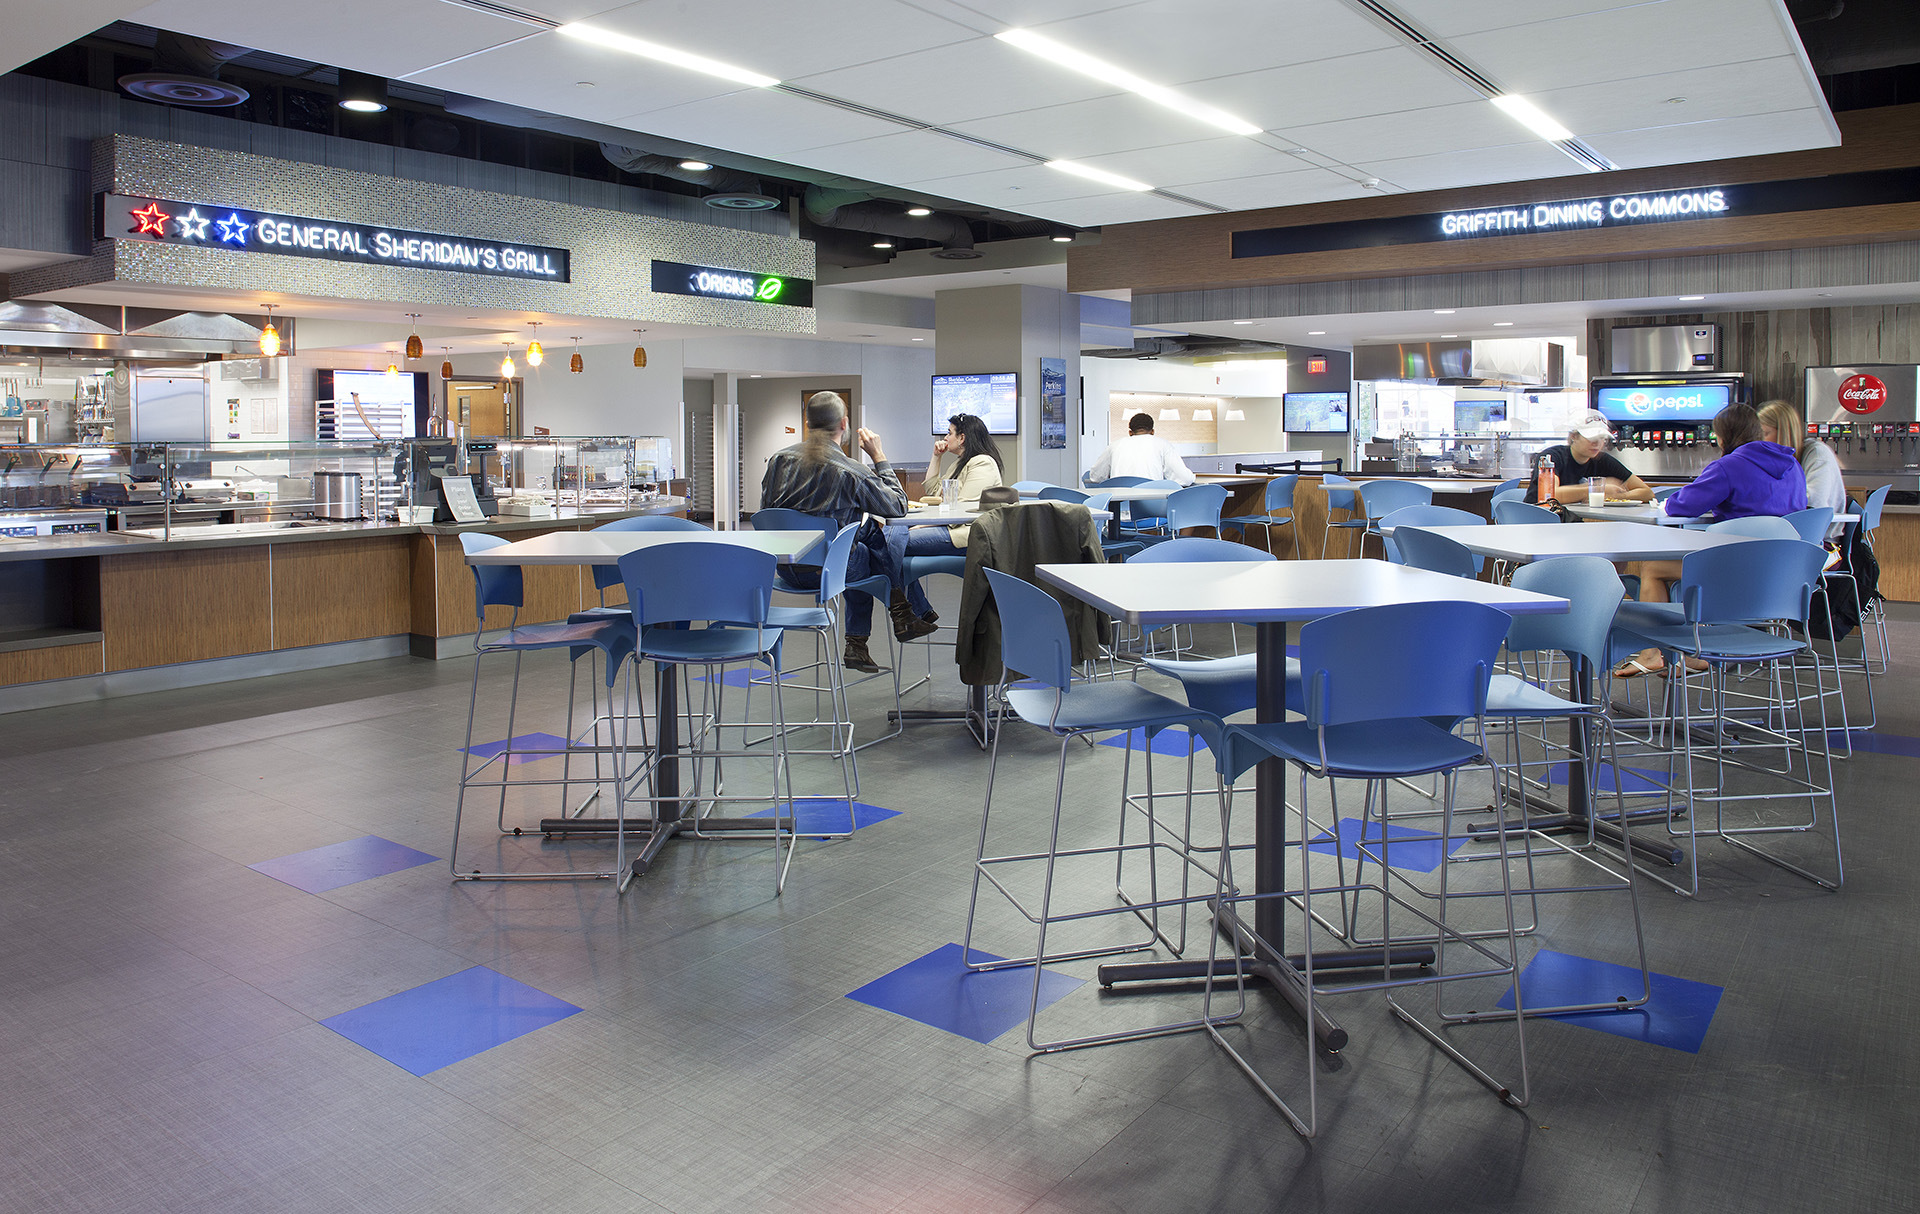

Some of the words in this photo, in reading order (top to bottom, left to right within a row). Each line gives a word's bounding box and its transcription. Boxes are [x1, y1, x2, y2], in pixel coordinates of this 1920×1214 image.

[1442, 209, 1528, 234] GRIFFITH
[1533, 201, 1602, 227] DINING
[1610, 191, 1725, 218] COMMONS
[258, 218, 368, 254] GENERAL
[375, 232, 496, 269] SHERIDAN'S
[502, 247, 556, 275] GRILL
[699, 271, 755, 296] ORIGINS
[1311, 361, 1324, 372] EXIT
[1045, 381, 1062, 391] Perkins
[1843, 388, 1880, 400] Coca-Cola
[1653, 393, 1704, 412] pepsi
